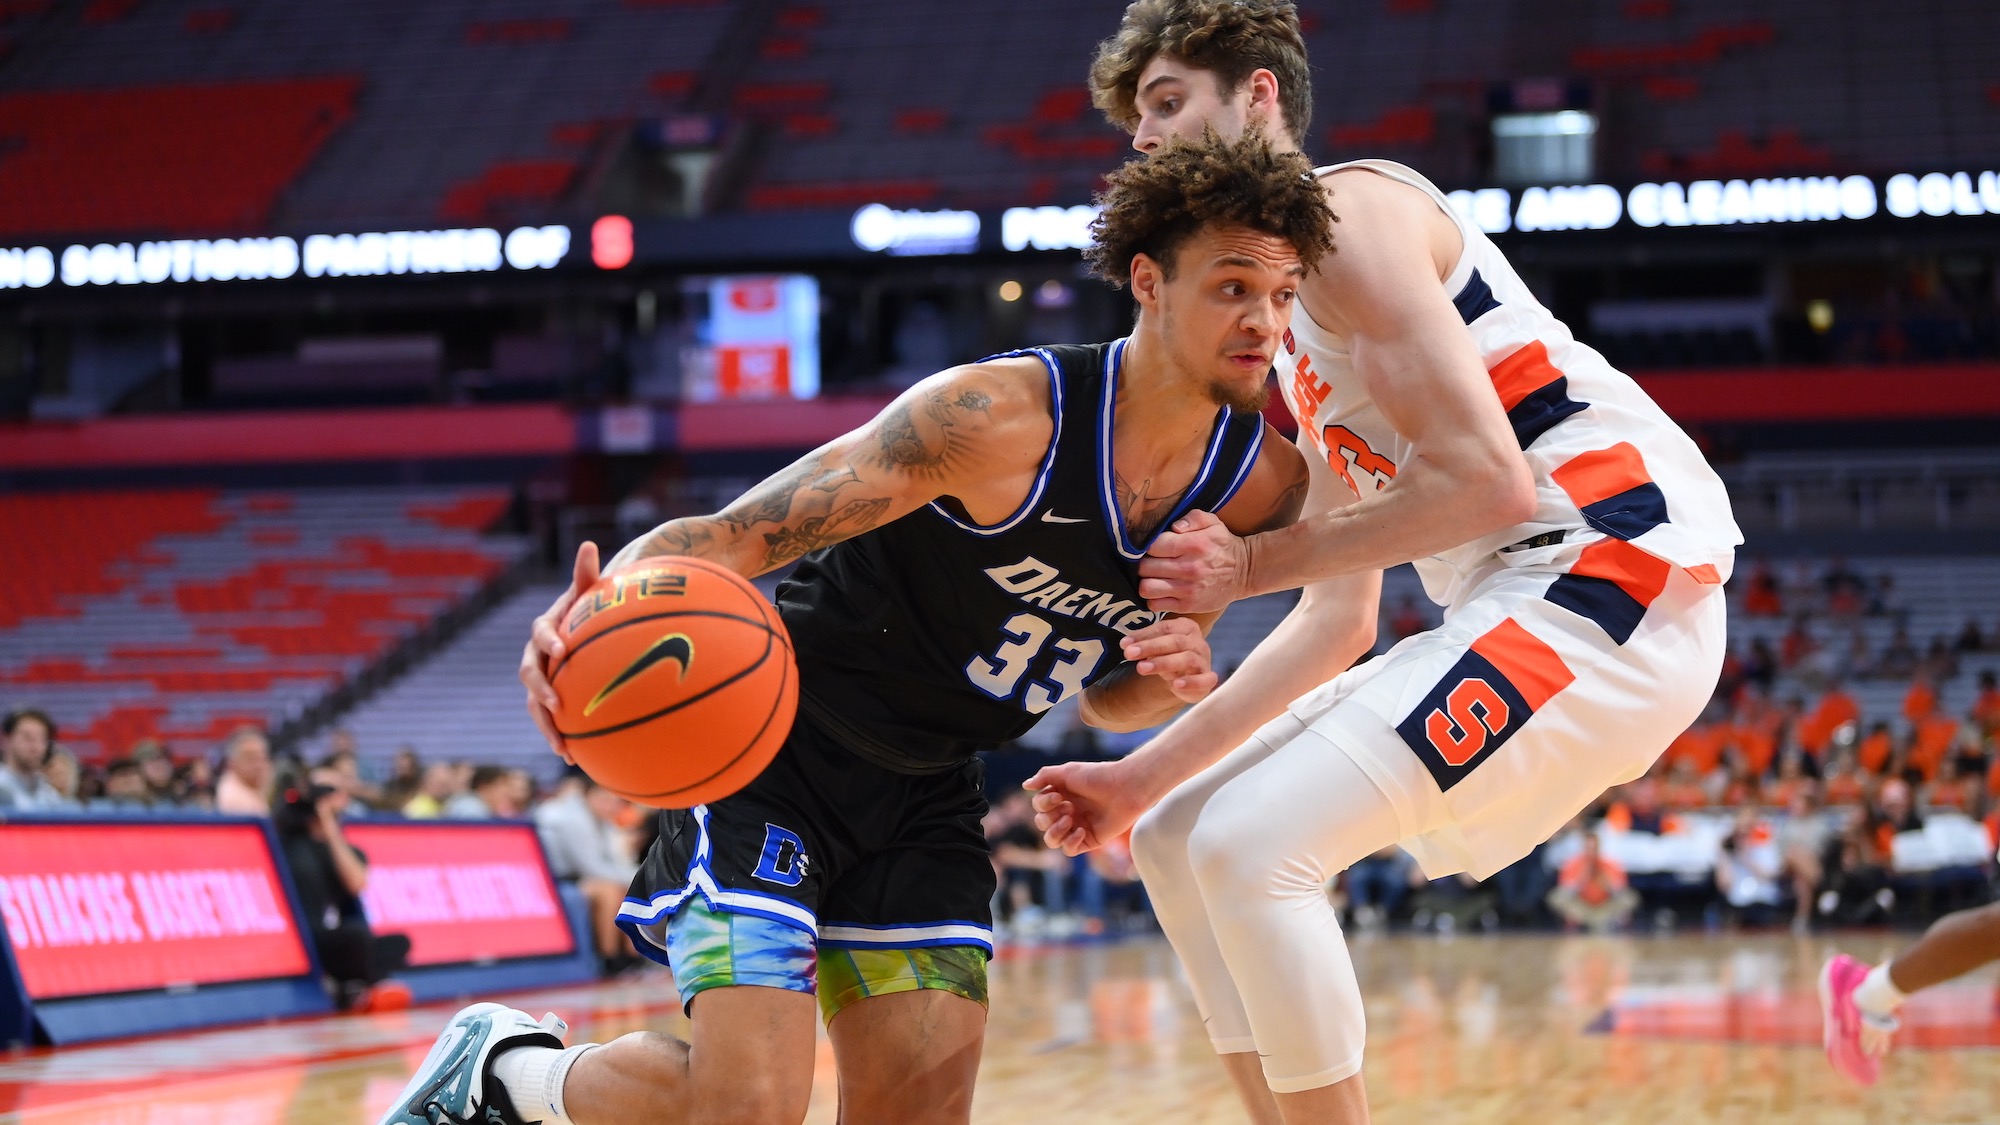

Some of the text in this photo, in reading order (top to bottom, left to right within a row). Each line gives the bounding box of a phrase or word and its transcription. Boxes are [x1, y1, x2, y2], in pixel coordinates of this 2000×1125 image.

[1514, 184, 1622, 232] AND
[1627, 174, 1877, 228] CLEANING
[61, 236, 300, 287] SOLUTIONS
[303, 227, 502, 279] PARTNER
[504, 224, 571, 270] OF
[982, 556, 1167, 637] DAEME
[964, 612, 1105, 715] 33
[1425, 677, 1511, 767] S
[130, 868, 287, 942] BASKETBALL
